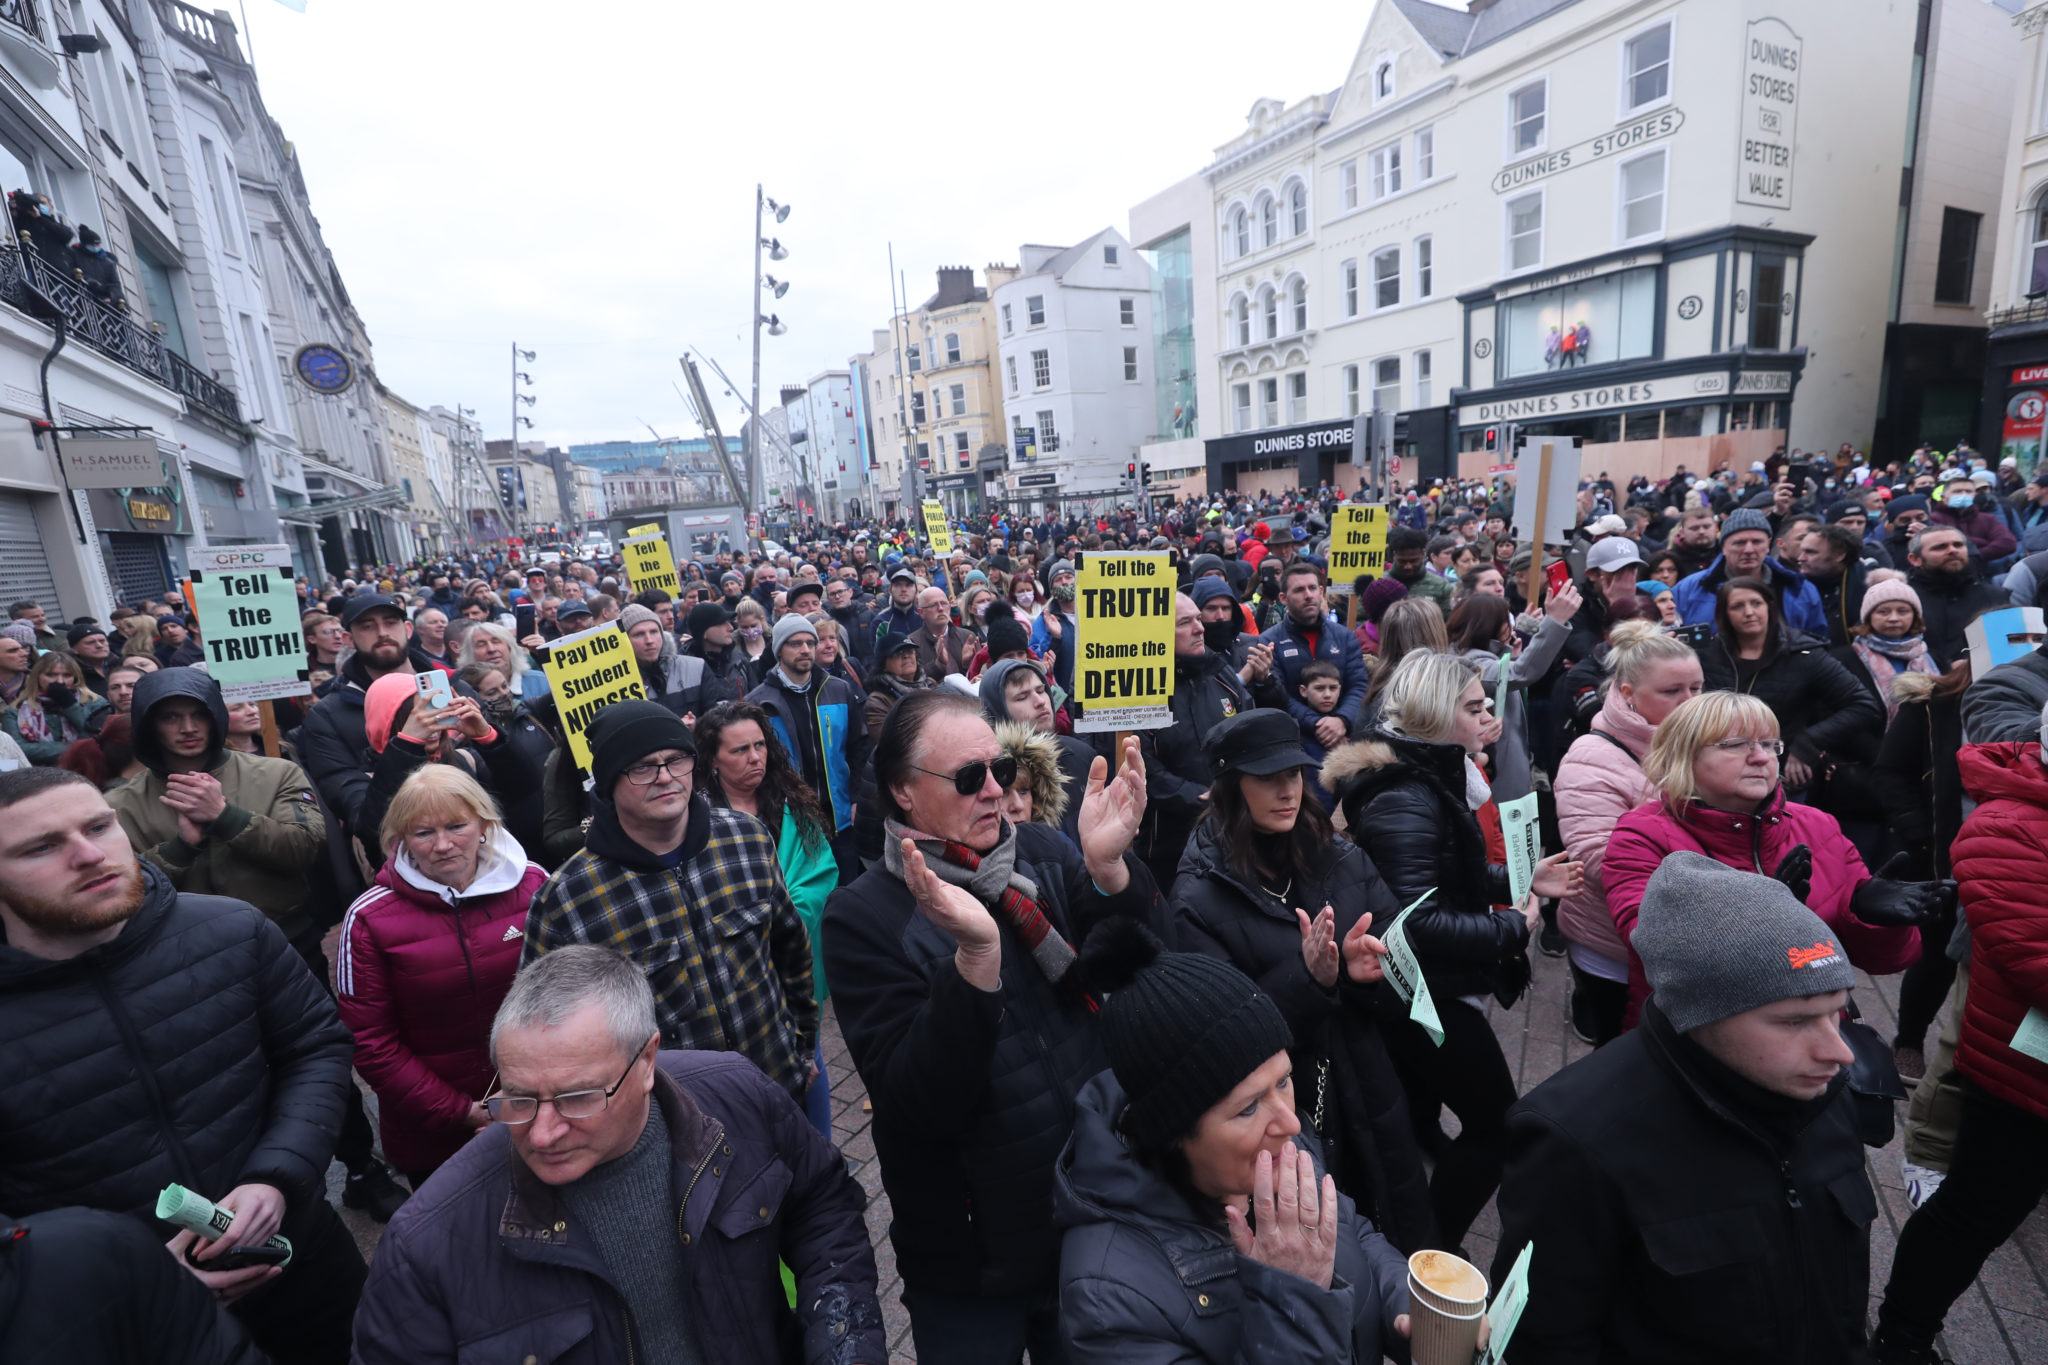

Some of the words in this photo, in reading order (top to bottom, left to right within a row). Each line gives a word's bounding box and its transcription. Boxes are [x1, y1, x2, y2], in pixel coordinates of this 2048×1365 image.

[1751, 39, 1797, 71] DUNNES
[1749, 74, 1795, 104] STORES
[1762, 114, 1778, 128] FOR
[1501, 152, 1571, 188] DUNNES
[1593, 115, 1673, 156] STORES
[1745, 140, 1789, 168] BETTER
[1749, 173, 1784, 198] VALUE
[1480, 396, 1559, 420] DUNNES
[1571, 383, 1653, 409] STORES
[1254, 434, 1305, 454] DUNNES
[72, 455, 151, 465] H.SAMUEL
[1348, 508, 1374, 523] Tell
[1347, 530, 1370, 544] the
[216, 553, 265, 564] CPPC
[633, 542, 657, 556] Tell
[1332, 551, 1382, 567] TRUTH!
[640, 560, 660, 573] the
[1099, 560, 1126, 576] Tell
[1131, 560, 1155, 576] the
[219, 574, 269, 596] Tell
[633, 573, 676, 592] TRUTH!
[1082, 587, 1170, 618] TRUTH
[228, 607, 271, 627] the
[208, 632, 300, 662] TRUTH!
[554, 646, 589, 669] Pay
[589, 633, 620, 657] the
[1085, 643, 1138, 659] Shame
[1142, 641, 1166, 656] the
[562, 660, 631, 699] Student
[1085, 667, 1167, 699] DEVIL!
[1512, 833, 1522, 857] PAPER
[1393, 942, 1415, 975] PAPER
[213, 1212, 233, 1231] IES
